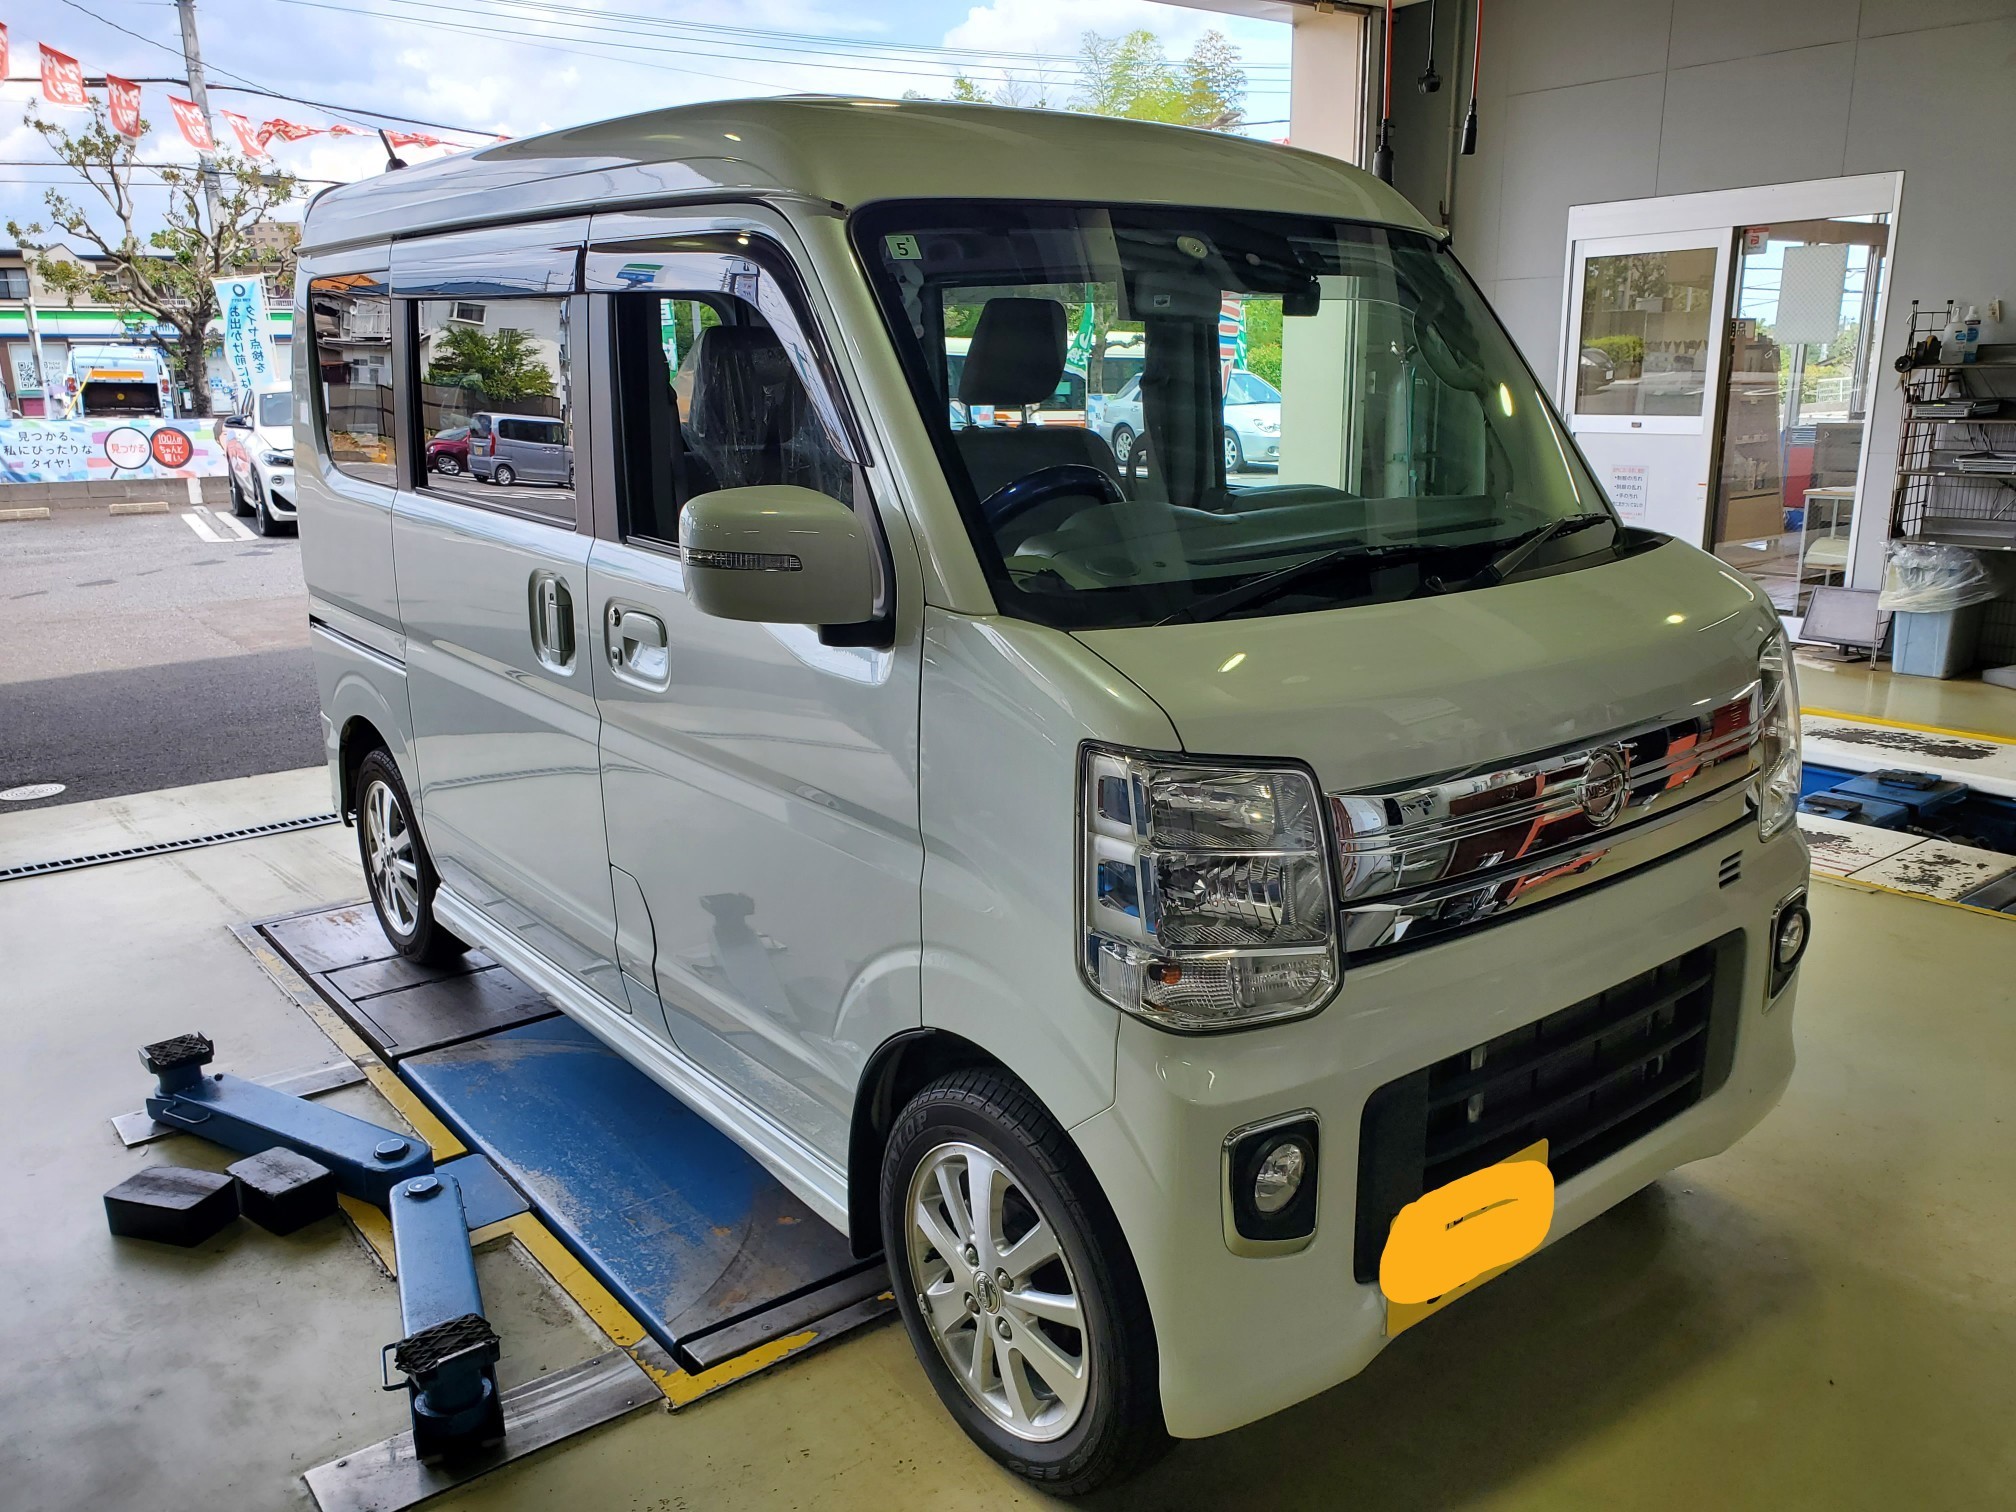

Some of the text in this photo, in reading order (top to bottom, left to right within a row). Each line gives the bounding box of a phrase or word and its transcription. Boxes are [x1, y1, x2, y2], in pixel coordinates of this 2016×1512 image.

[896, 242, 909, 256] 5
[18, 431, 76, 442] 見つかる、
[111, 443, 146, 454] 見つかる
[159, 445, 184, 454] ちゃんと
[31, 458, 71, 469] タイヤ!
